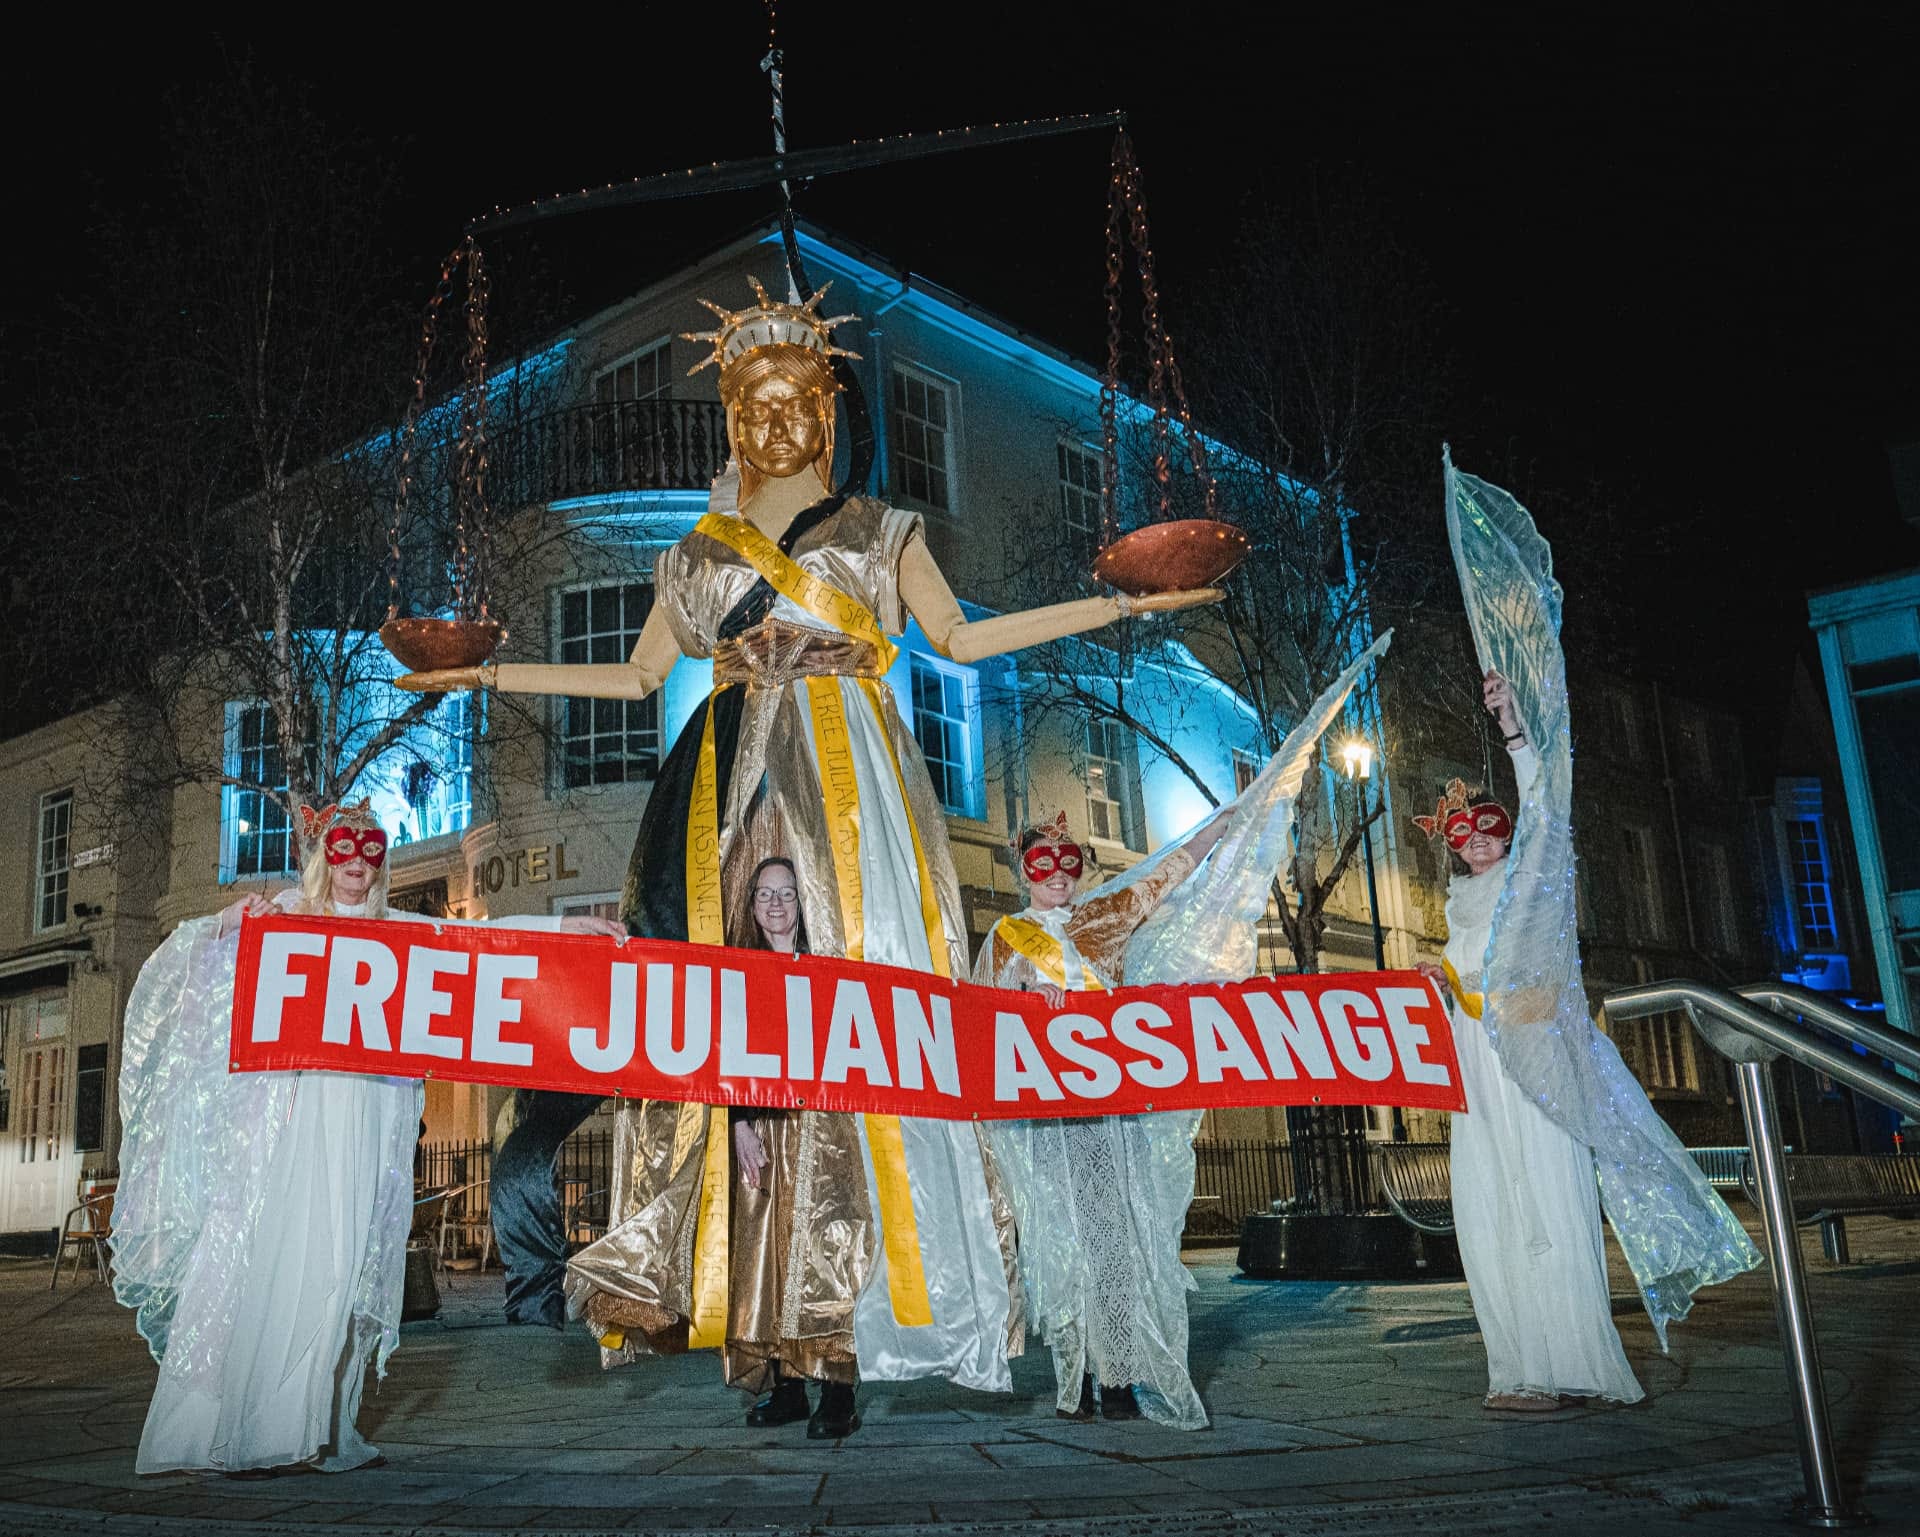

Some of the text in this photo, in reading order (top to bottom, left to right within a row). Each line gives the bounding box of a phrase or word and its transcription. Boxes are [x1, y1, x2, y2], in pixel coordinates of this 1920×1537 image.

[792, 574, 841, 612] FREE
[840, 602, 882, 634] SPEE
[815, 691, 839, 743] FREE
[825, 746, 855, 818] JULIAN
[473, 843, 580, 897] HOTEL
[694, 823, 721, 931] ASSANGE
[252, 932, 1451, 1102] FREE JULIAN ASSANGE
[704, 1170, 724, 1225] FREE
[702, 1240, 723, 1320] SPEECH
